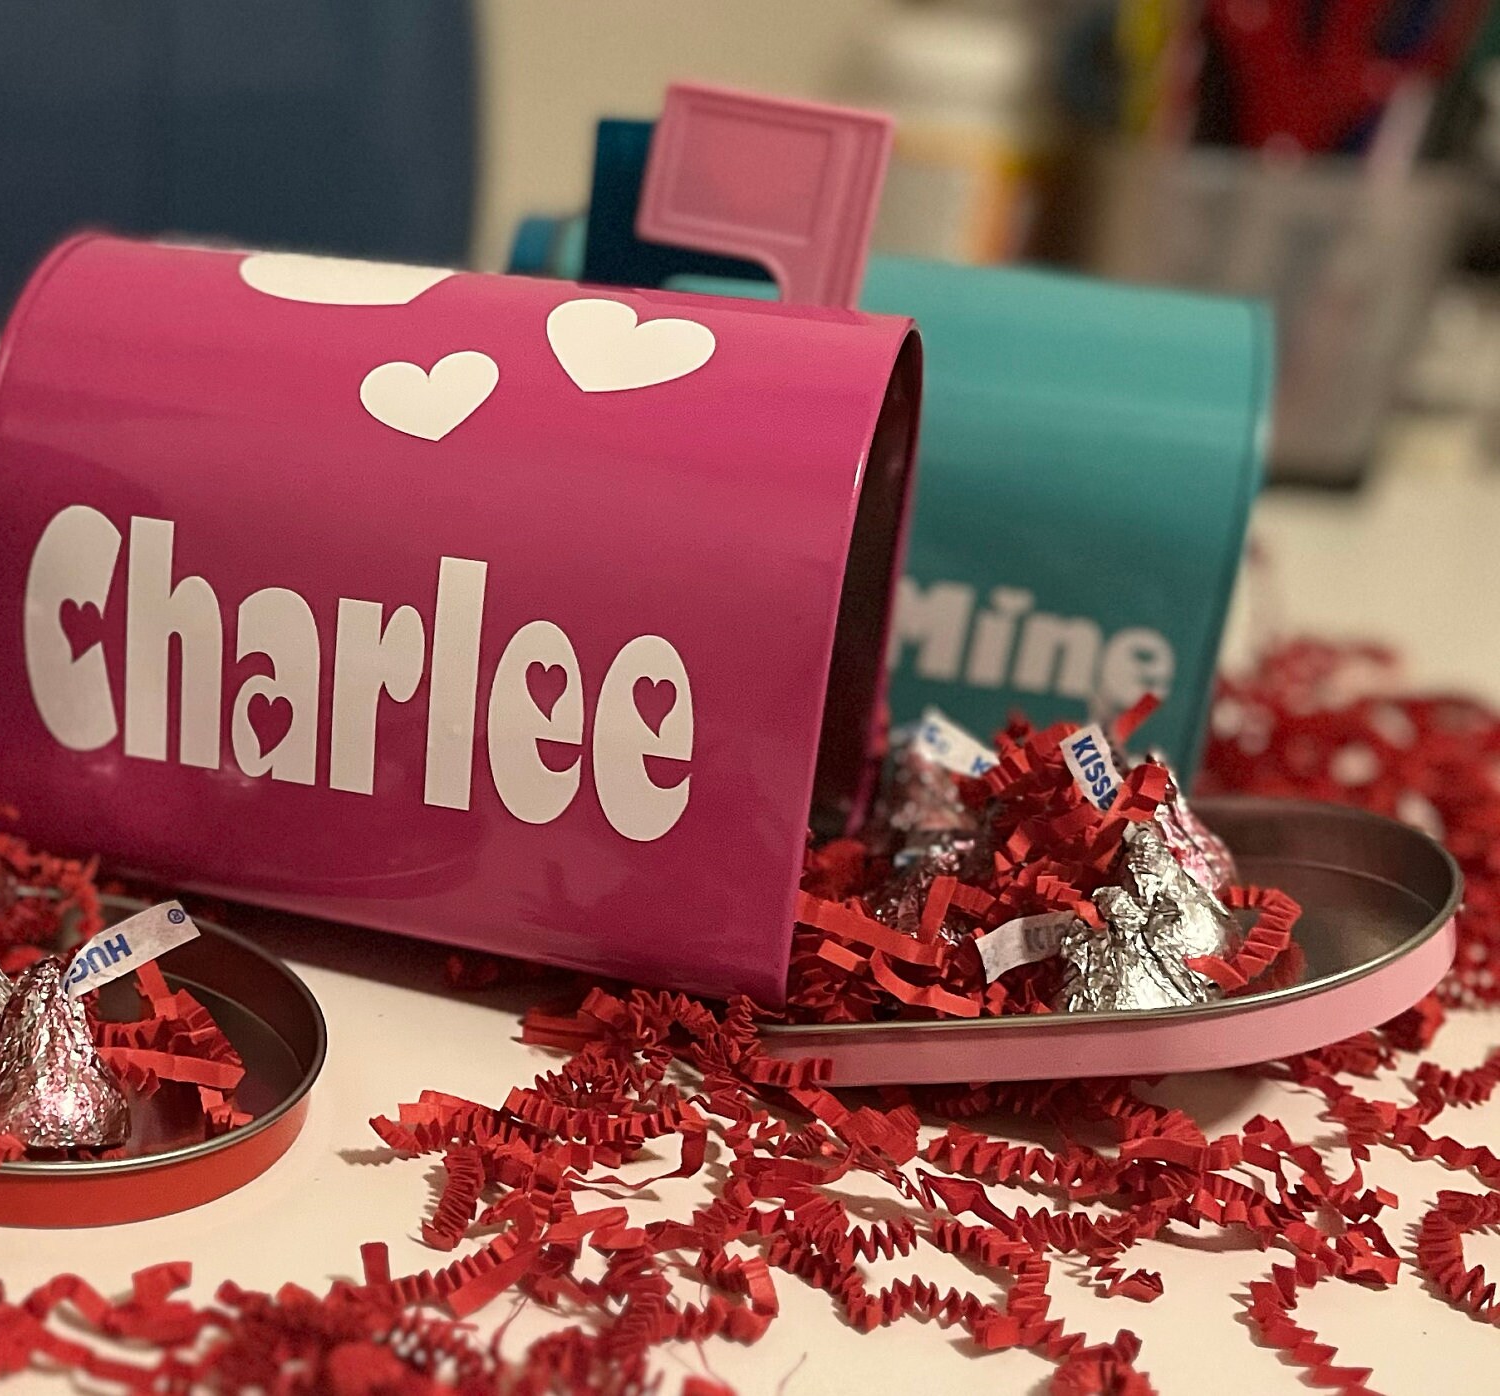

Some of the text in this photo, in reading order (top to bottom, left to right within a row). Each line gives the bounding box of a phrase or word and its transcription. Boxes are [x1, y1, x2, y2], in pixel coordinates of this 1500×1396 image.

[22, 504, 695, 843] Charlee
[886, 575, 1176, 706] Mine
[64, 933, 133, 994] HUG
